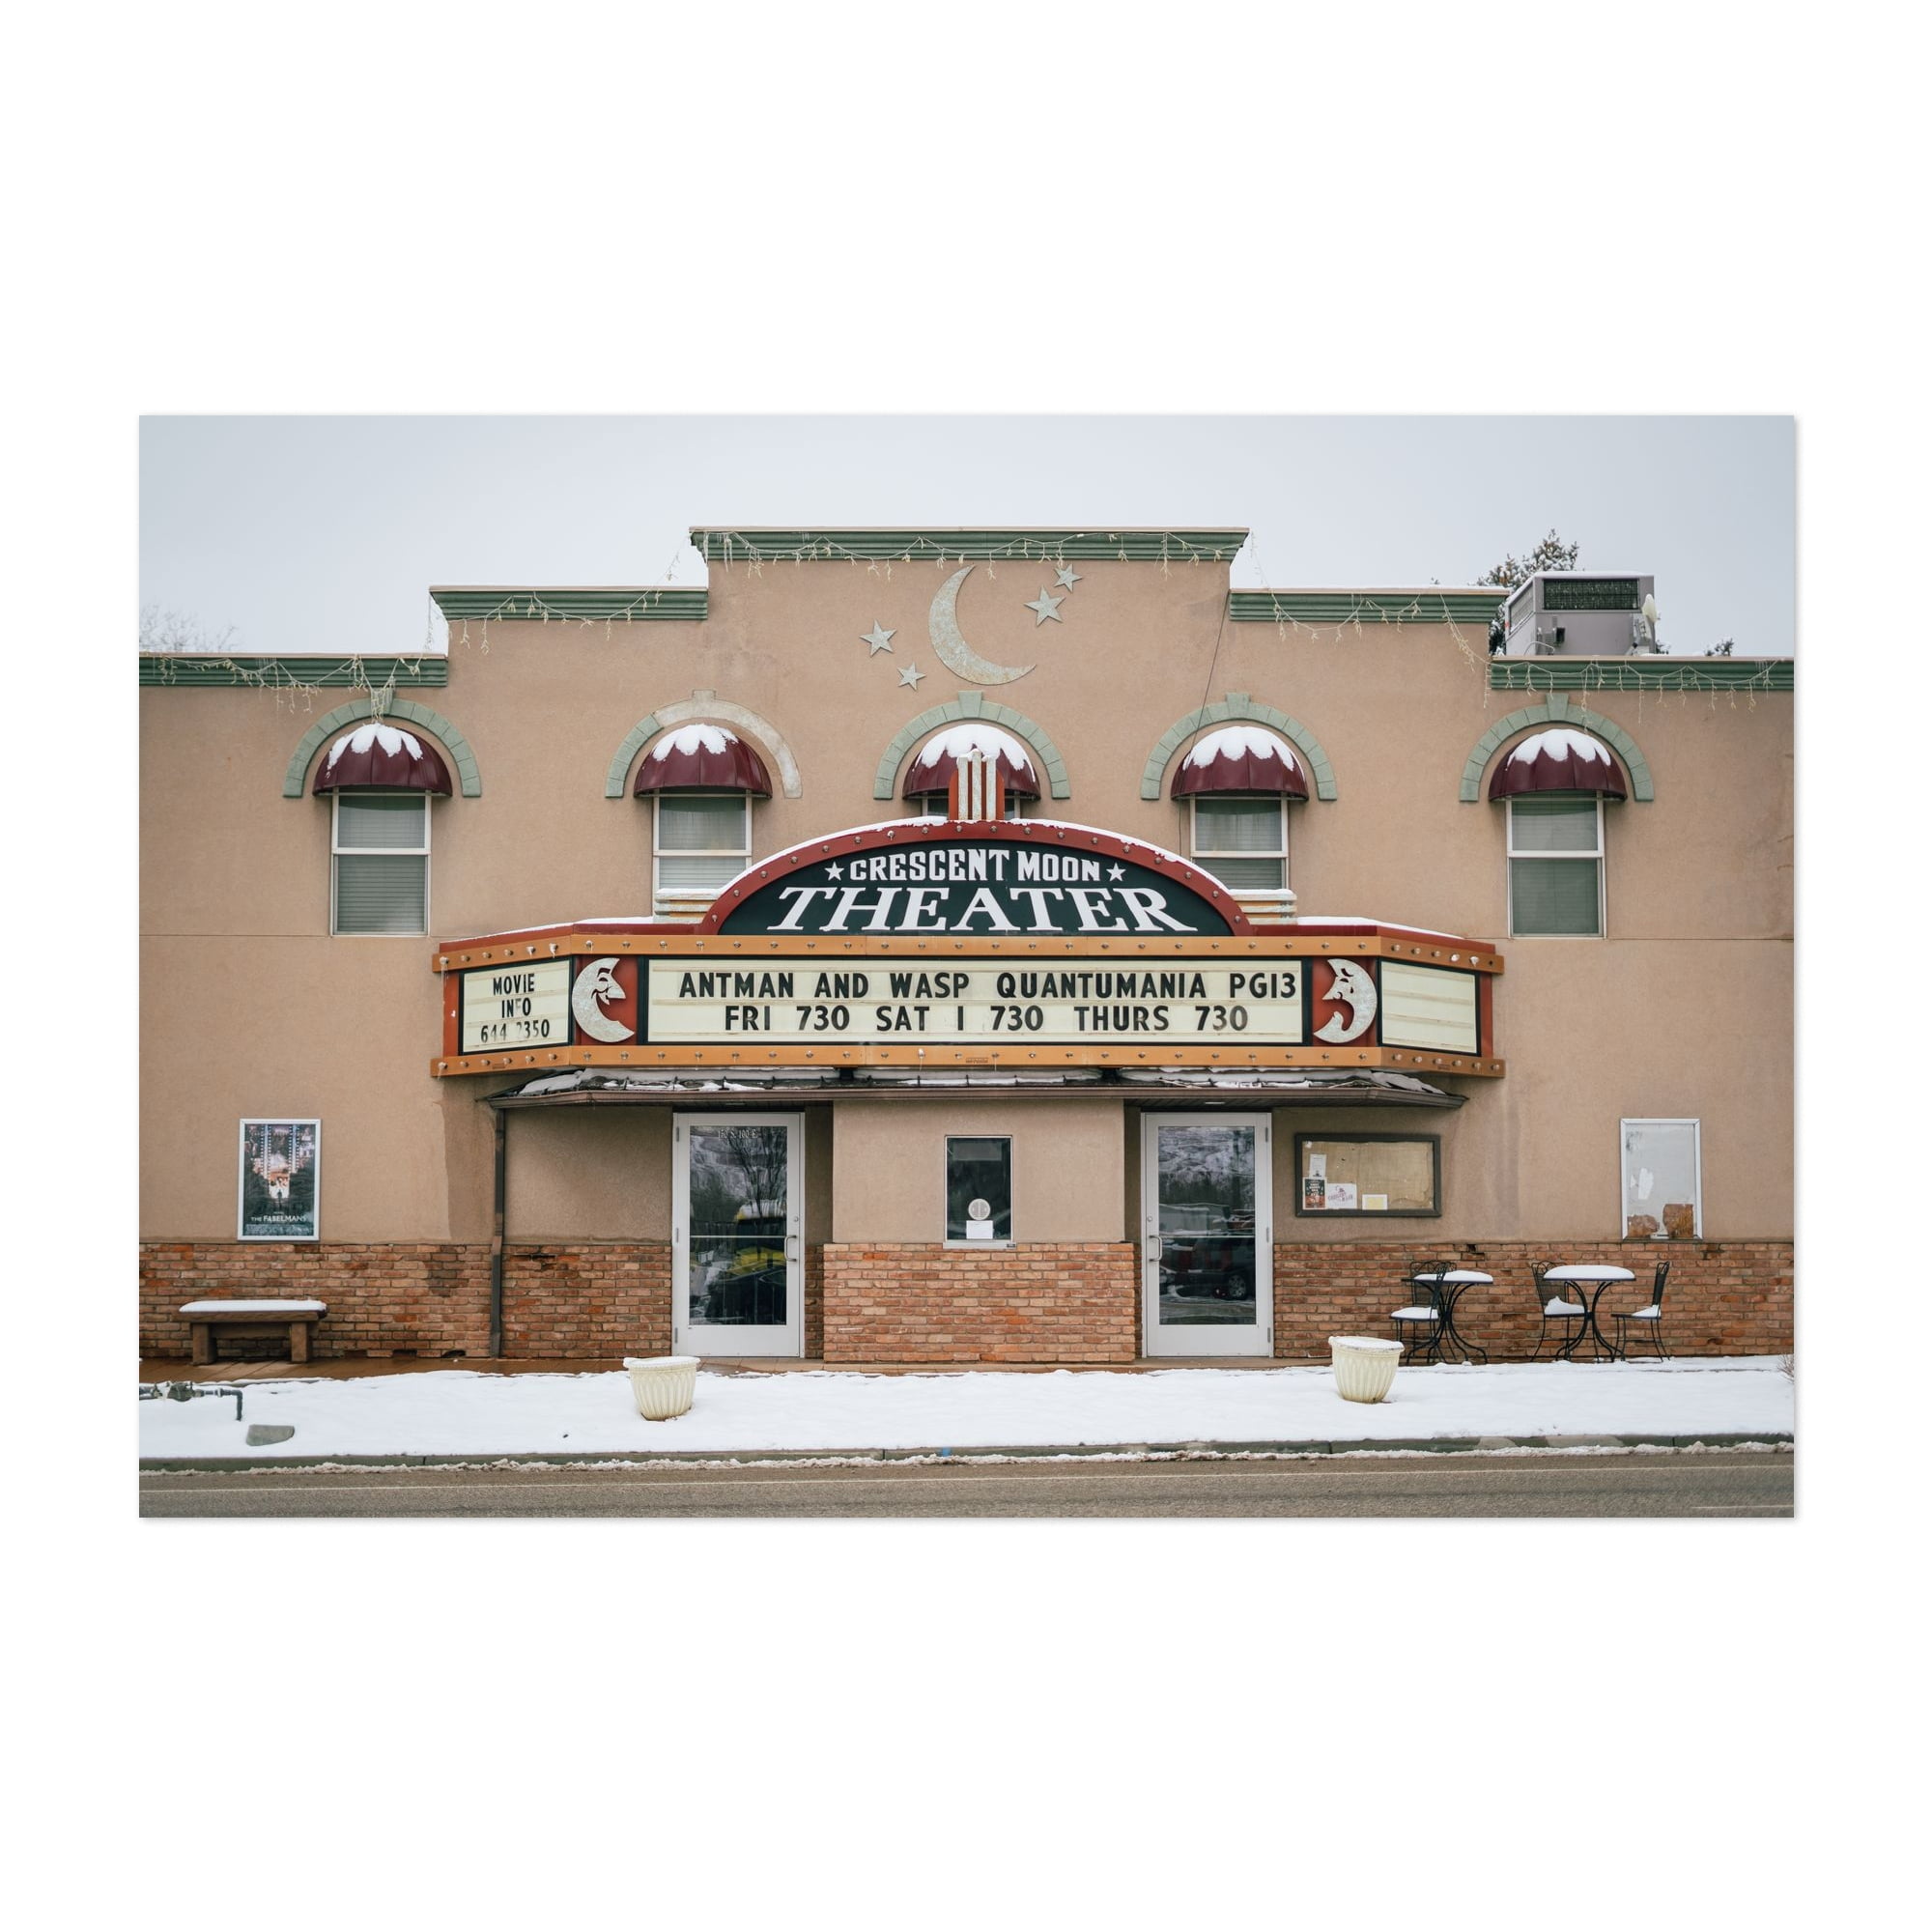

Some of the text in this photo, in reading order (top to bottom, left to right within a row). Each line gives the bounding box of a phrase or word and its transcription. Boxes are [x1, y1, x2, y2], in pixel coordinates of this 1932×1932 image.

[849, 848, 1100, 882] CRESCENT MOON
[767, 887, 1199, 931] THEATER
[493, 973, 535, 996] MOVIE
[679, 972, 794, 998] ANTMAN
[814, 972, 869, 999] AND
[890, 972, 970, 999] WASP
[996, 972, 1207, 999] QUANTUMANIA
[724, 1005, 771, 1031] FRI
[796, 1005, 850, 1032] 730
[876, 1005, 930, 1032] SAT
[990, 1005, 1044, 1032] 730
[1074, 1005, 1170, 1032] THURS
[1195, 1005, 1248, 1032] 730
[480, 1023, 507, 1042] 644
